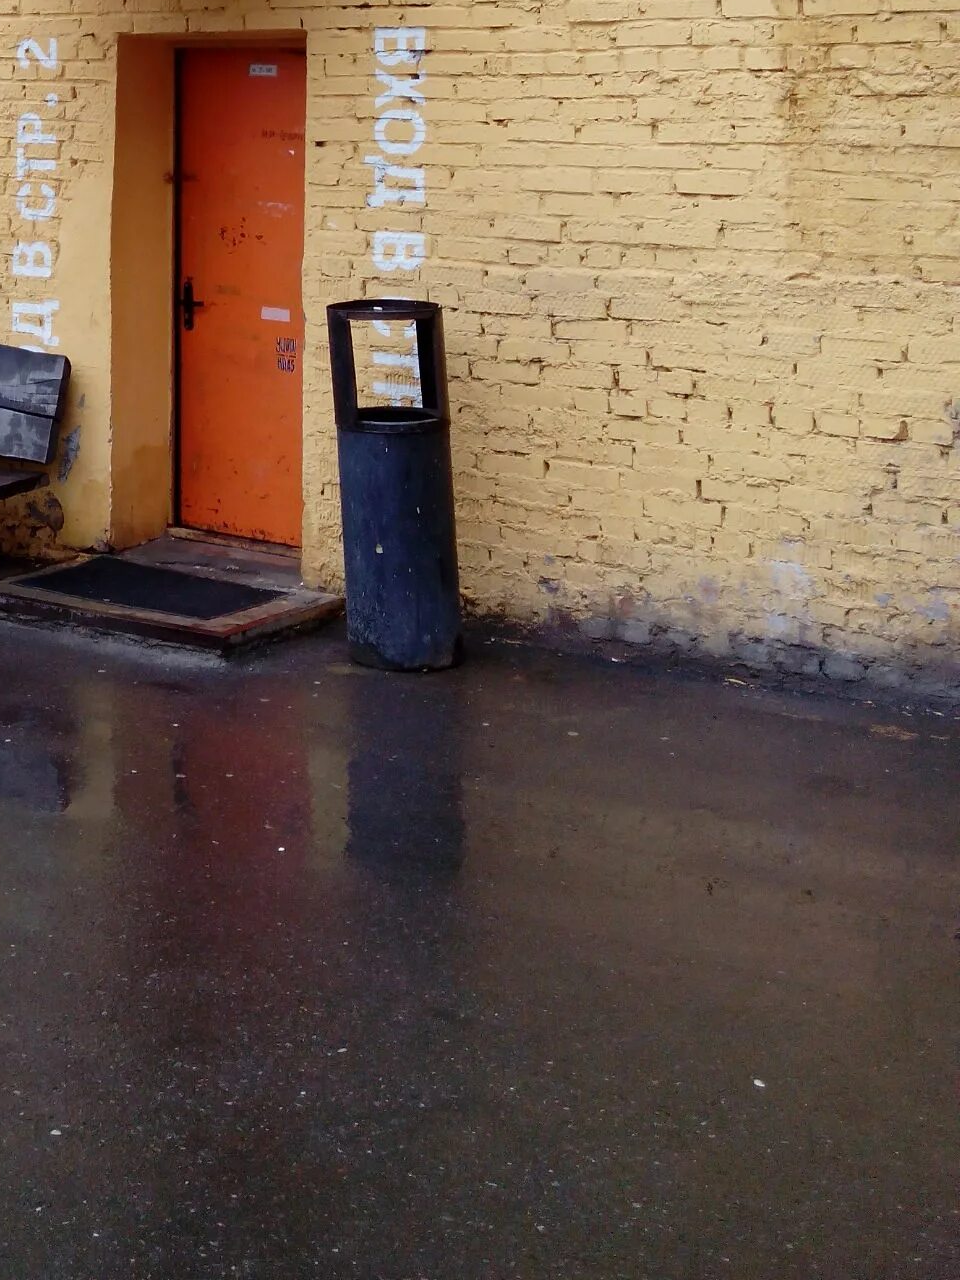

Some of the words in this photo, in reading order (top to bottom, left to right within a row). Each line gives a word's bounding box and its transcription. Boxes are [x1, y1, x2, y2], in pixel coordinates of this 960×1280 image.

[17, 36, 58, 69] 2
[364, 26, 428, 209] ВХОД
[15, 92, 58, 221] СТР.
[12, 239, 53, 279] В
[371, 230, 427, 273] В
